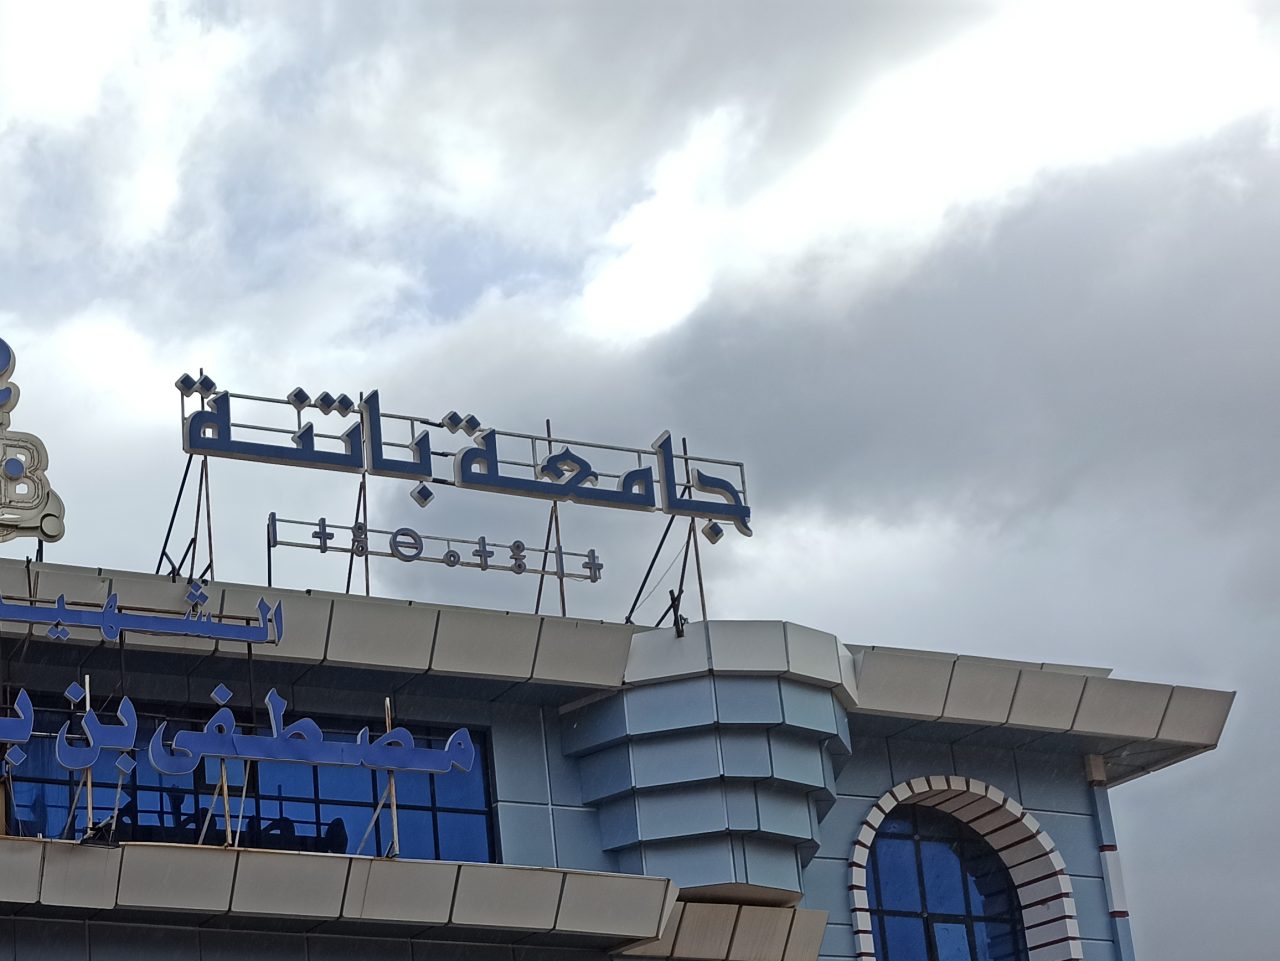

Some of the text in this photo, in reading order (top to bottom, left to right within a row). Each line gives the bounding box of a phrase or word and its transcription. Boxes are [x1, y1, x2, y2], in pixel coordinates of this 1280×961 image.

[174, 372, 753, 544] جامعة باتنة
[55, 681, 139, 775] بن
[149, 682, 477, 775] مصطفى
